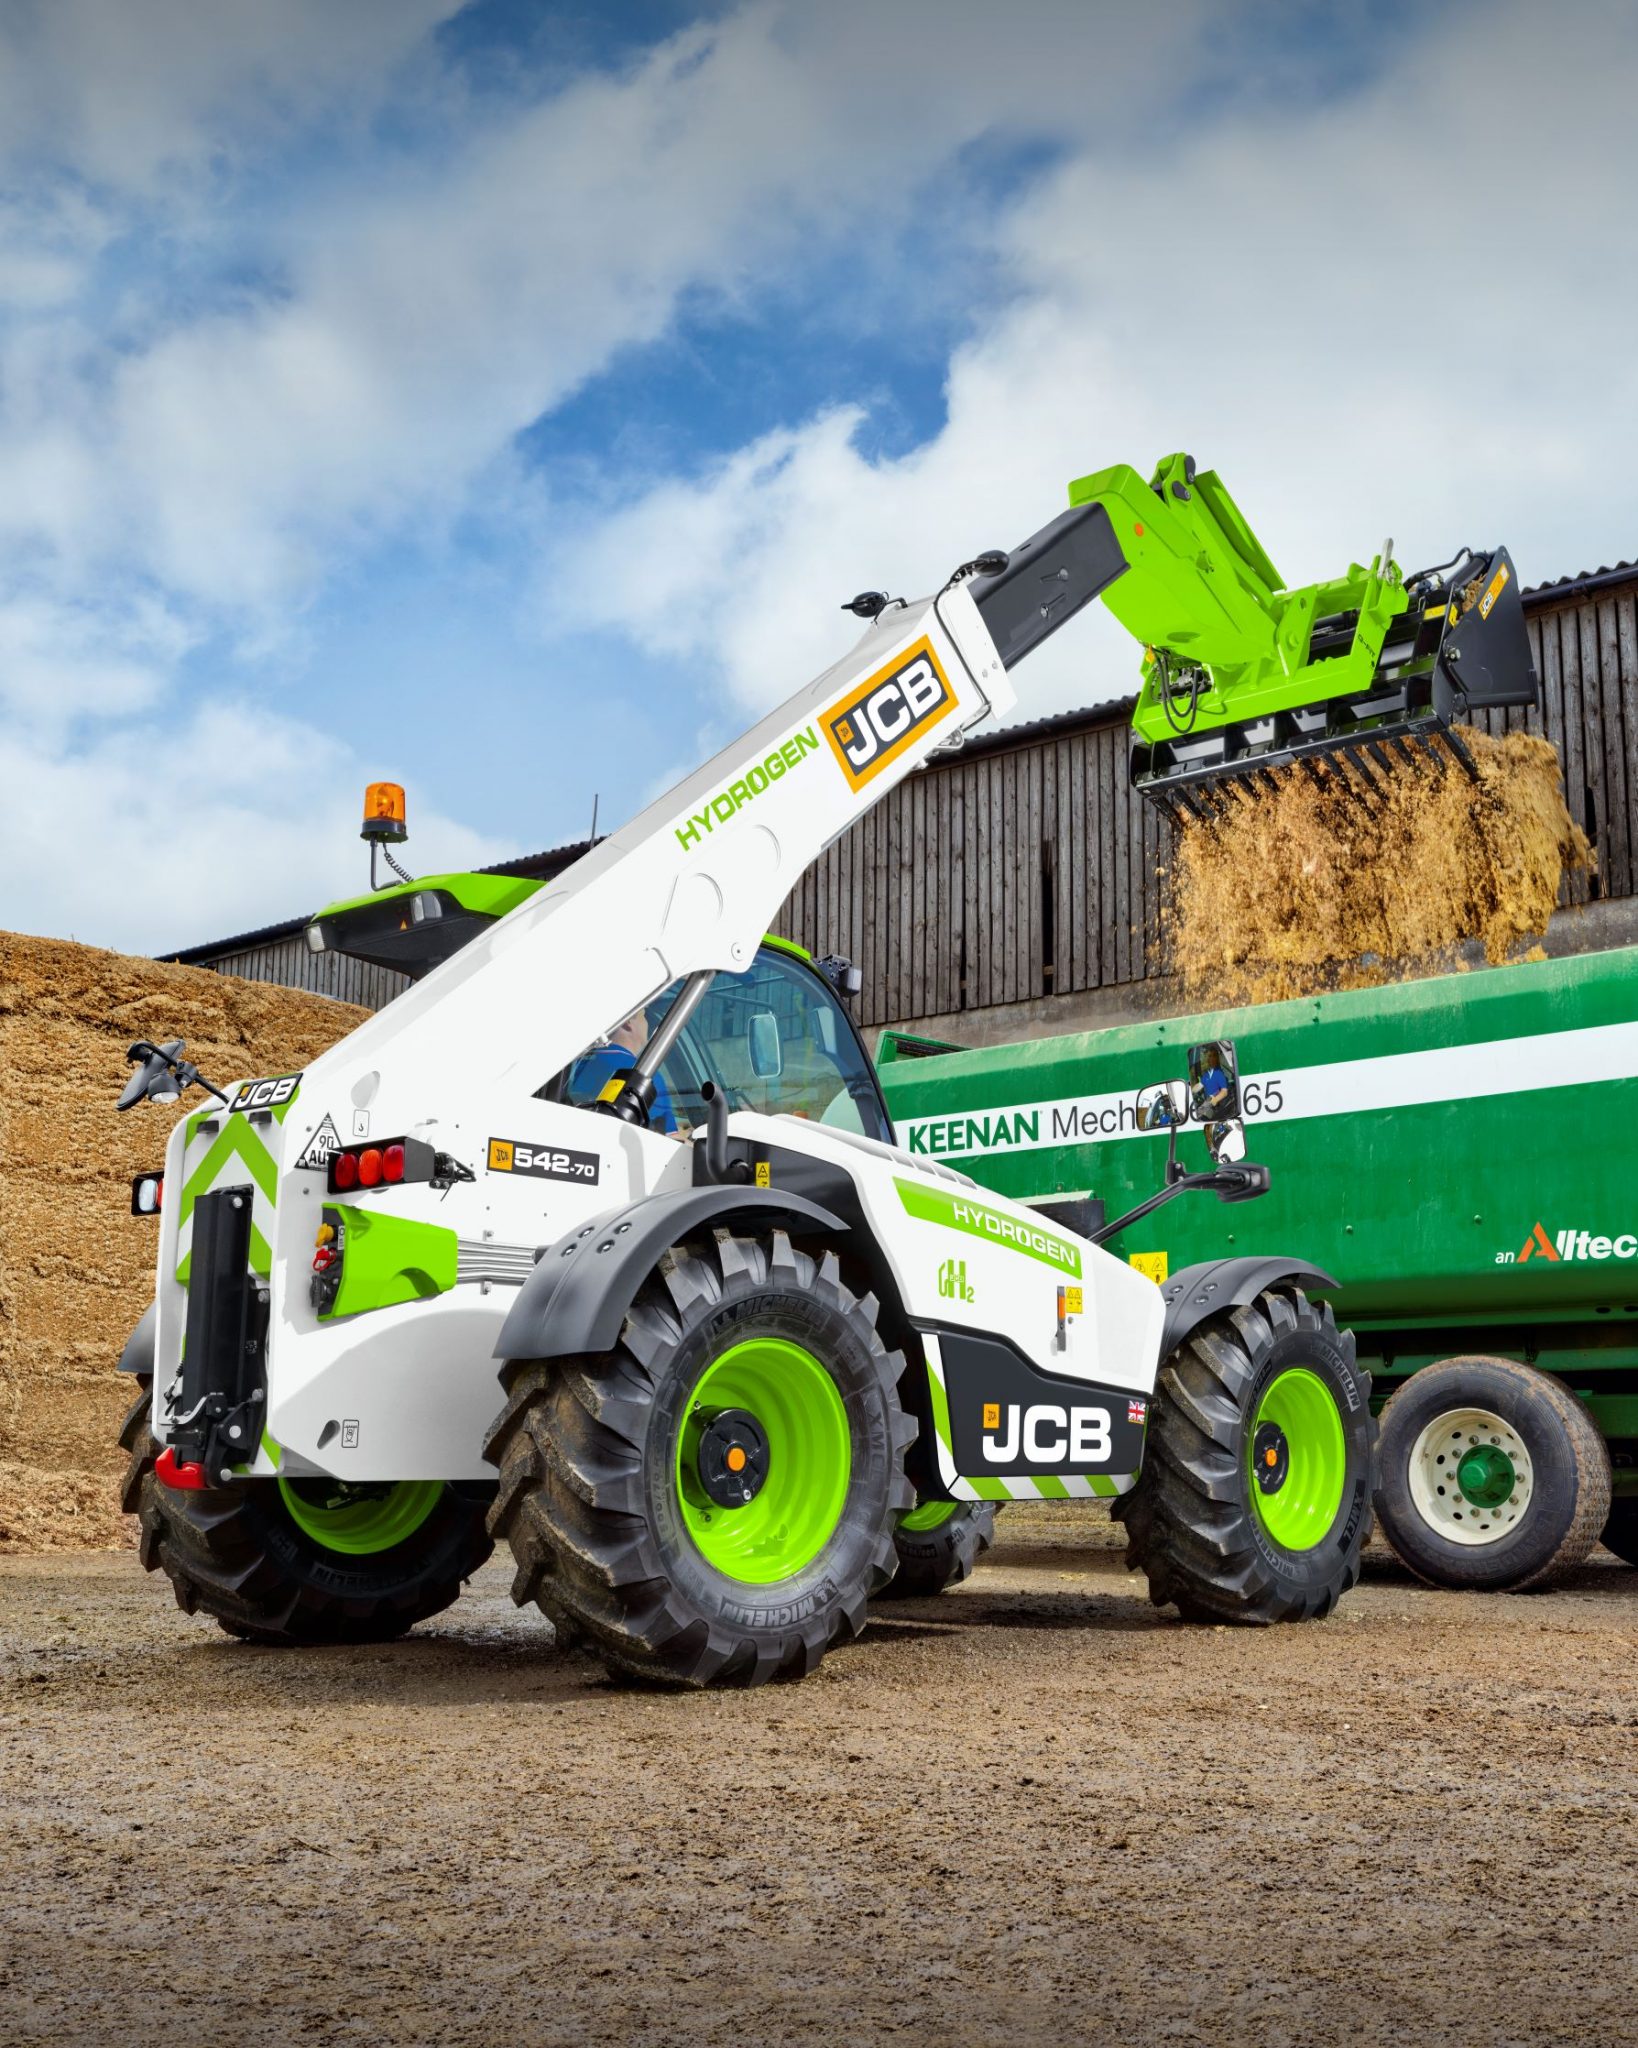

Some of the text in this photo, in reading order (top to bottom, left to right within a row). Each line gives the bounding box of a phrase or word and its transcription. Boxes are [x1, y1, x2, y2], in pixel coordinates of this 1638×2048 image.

[847, 659, 943, 767] JCB
[674, 726, 820, 851] HYDROGEN
[235, 1078, 297, 1108] JCB
[909, 1110, 1039, 1154] KEENAN
[514, 1147, 595, 1177] 542-70
[953, 1202, 1076, 1267] HYDROGEN
[1495, 1221, 1638, 1264] an Alltec
[983, 1404, 1112, 1463] JCB
[719, 1596, 816, 1628] MICHELIN
